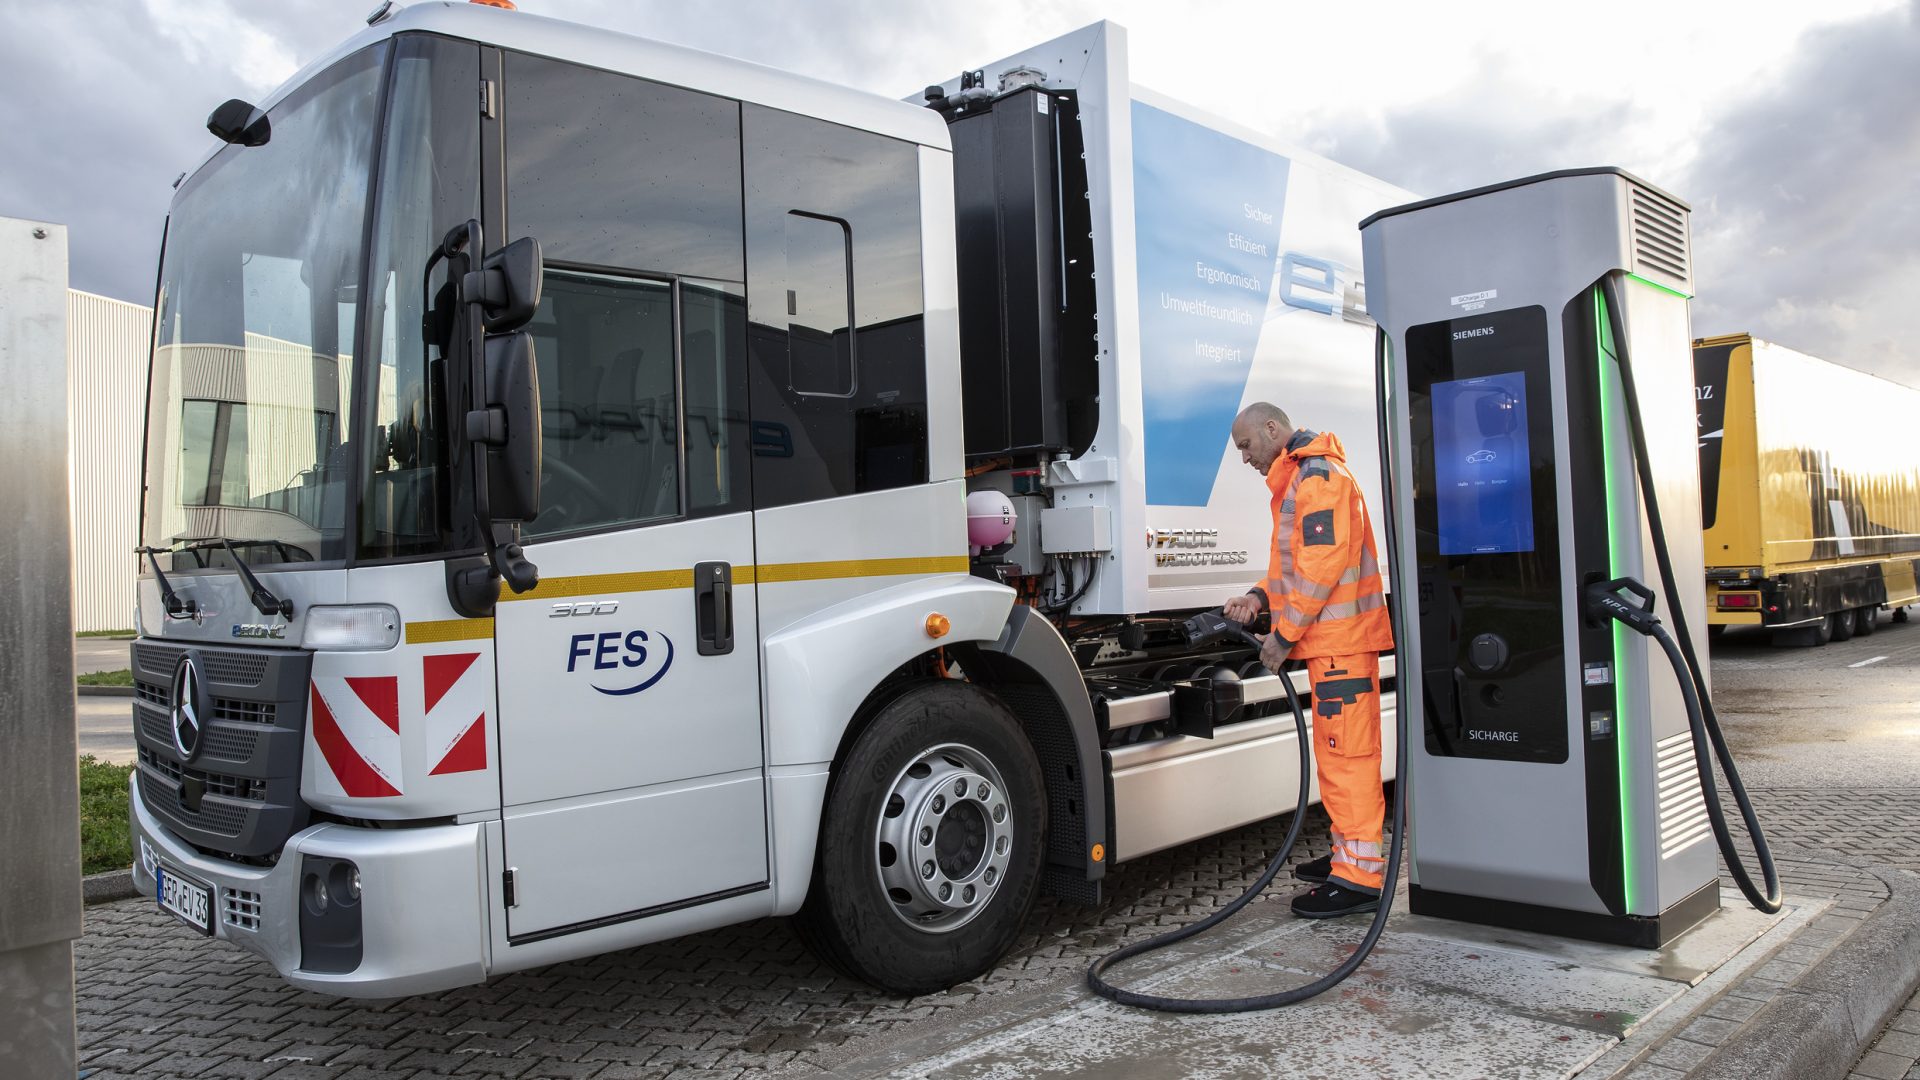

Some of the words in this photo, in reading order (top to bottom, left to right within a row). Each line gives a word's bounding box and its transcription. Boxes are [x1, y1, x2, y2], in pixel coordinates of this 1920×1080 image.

[1243, 202, 1273, 225] Sicher
[1228, 232, 1267, 258] Effizient
[1196, 261, 1261, 292] Ergonomisch
[1161, 291, 1253, 326] Umweltfreundlich
[1453, 326, 1495, 341] SIEMENS
[1195, 339, 1242, 363] Integriert
[1156, 528, 1217, 548] FAUN
[1155, 551, 1247, 567] VARIOPRESS
[549, 600, 620, 619] 300
[1602, 598, 1628, 613] HPC
[567, 629, 649, 673] FES
[1469, 729, 1519, 742] SICHARGE
[162, 874, 178, 909] GER
[183, 884, 194, 917] EV
[196, 891, 207, 924] 33
